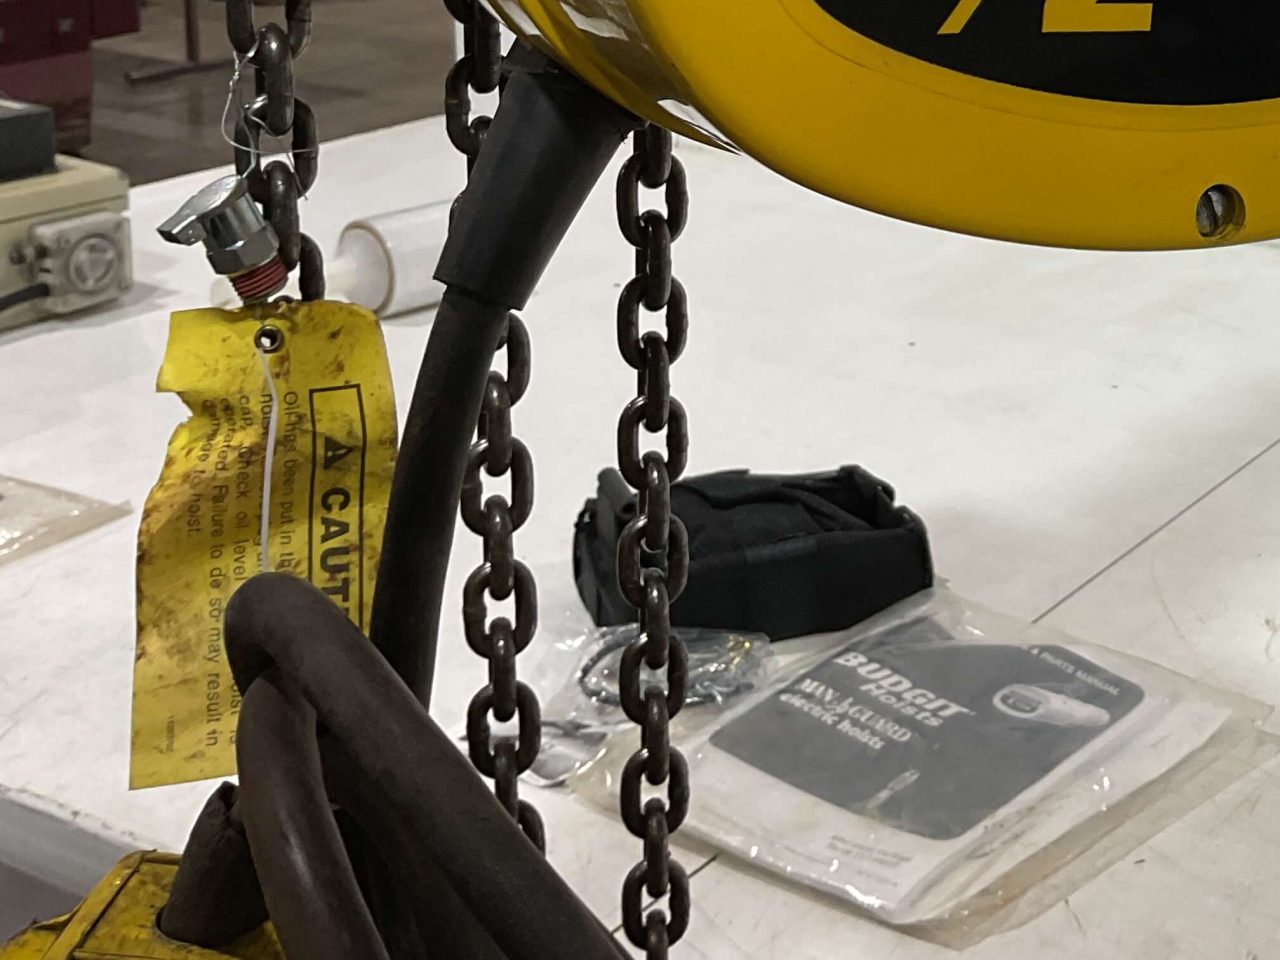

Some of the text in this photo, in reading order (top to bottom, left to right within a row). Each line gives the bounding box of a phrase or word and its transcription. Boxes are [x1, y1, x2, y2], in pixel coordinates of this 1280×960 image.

[281, 458, 297, 497] been
[210, 484, 229, 538] Failure
[209, 543, 225, 559] to
[279, 530, 296, 546] in
[320, 486, 352, 617] CAUT
[232, 539, 249, 581] level
[202, 626, 222, 663] may
[205, 672, 222, 724] result
[833, 652, 971, 717] BUDGIT
[205, 730, 221, 747] in
